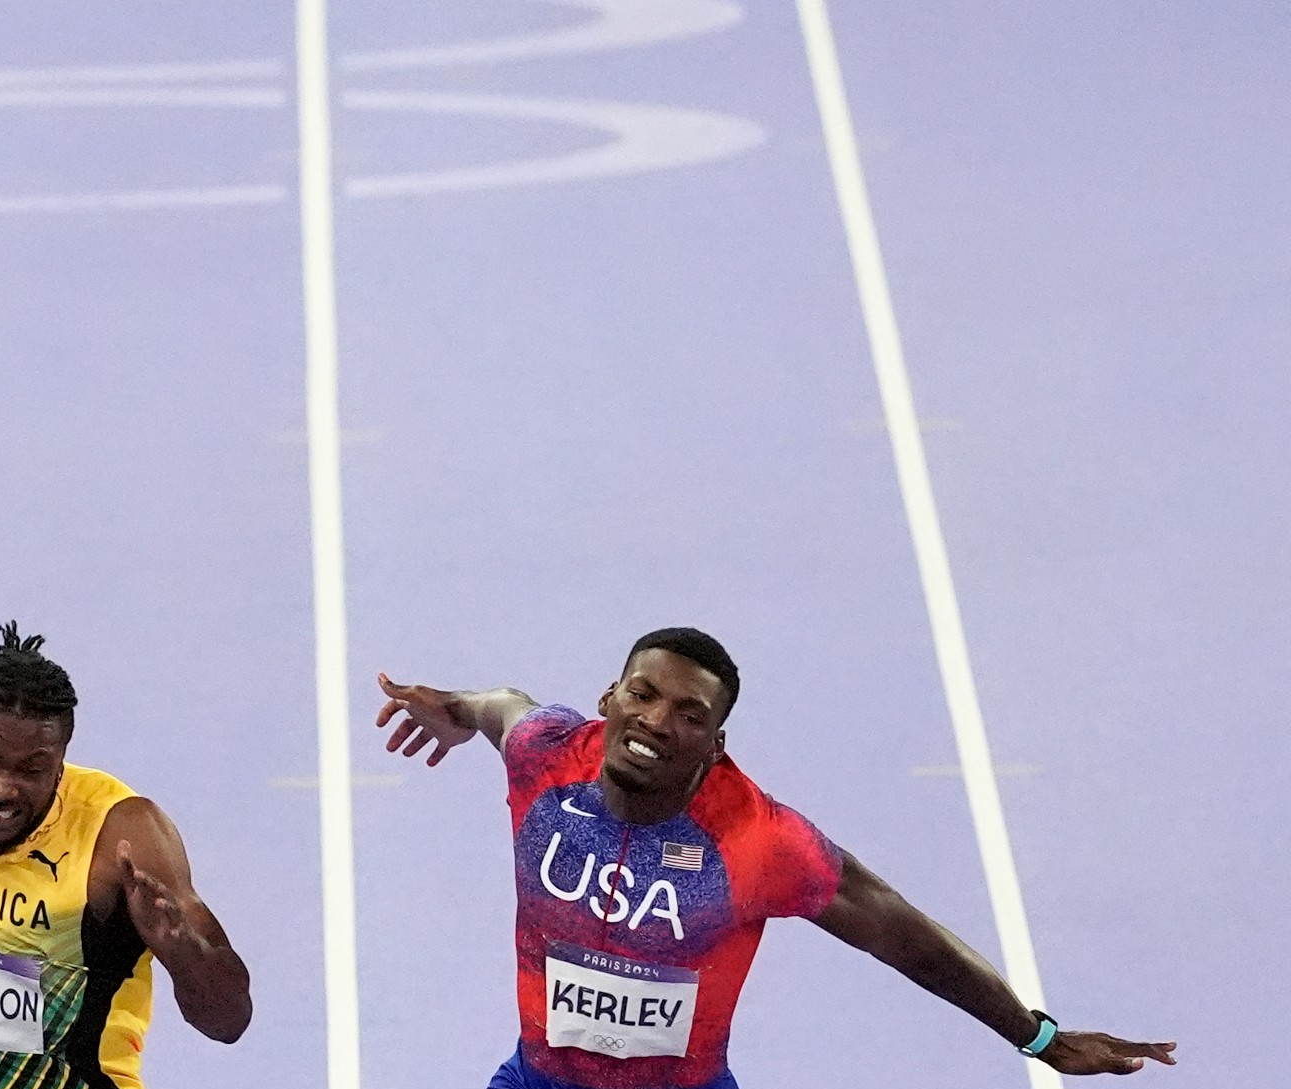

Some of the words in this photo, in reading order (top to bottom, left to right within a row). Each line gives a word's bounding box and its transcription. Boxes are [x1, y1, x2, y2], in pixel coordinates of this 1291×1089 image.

[540, 831, 685, 940] USA
[583, 953, 621, 970] PARIS
[624, 963, 659, 978] 2024
[552, 980, 682, 1028] KERLEY
